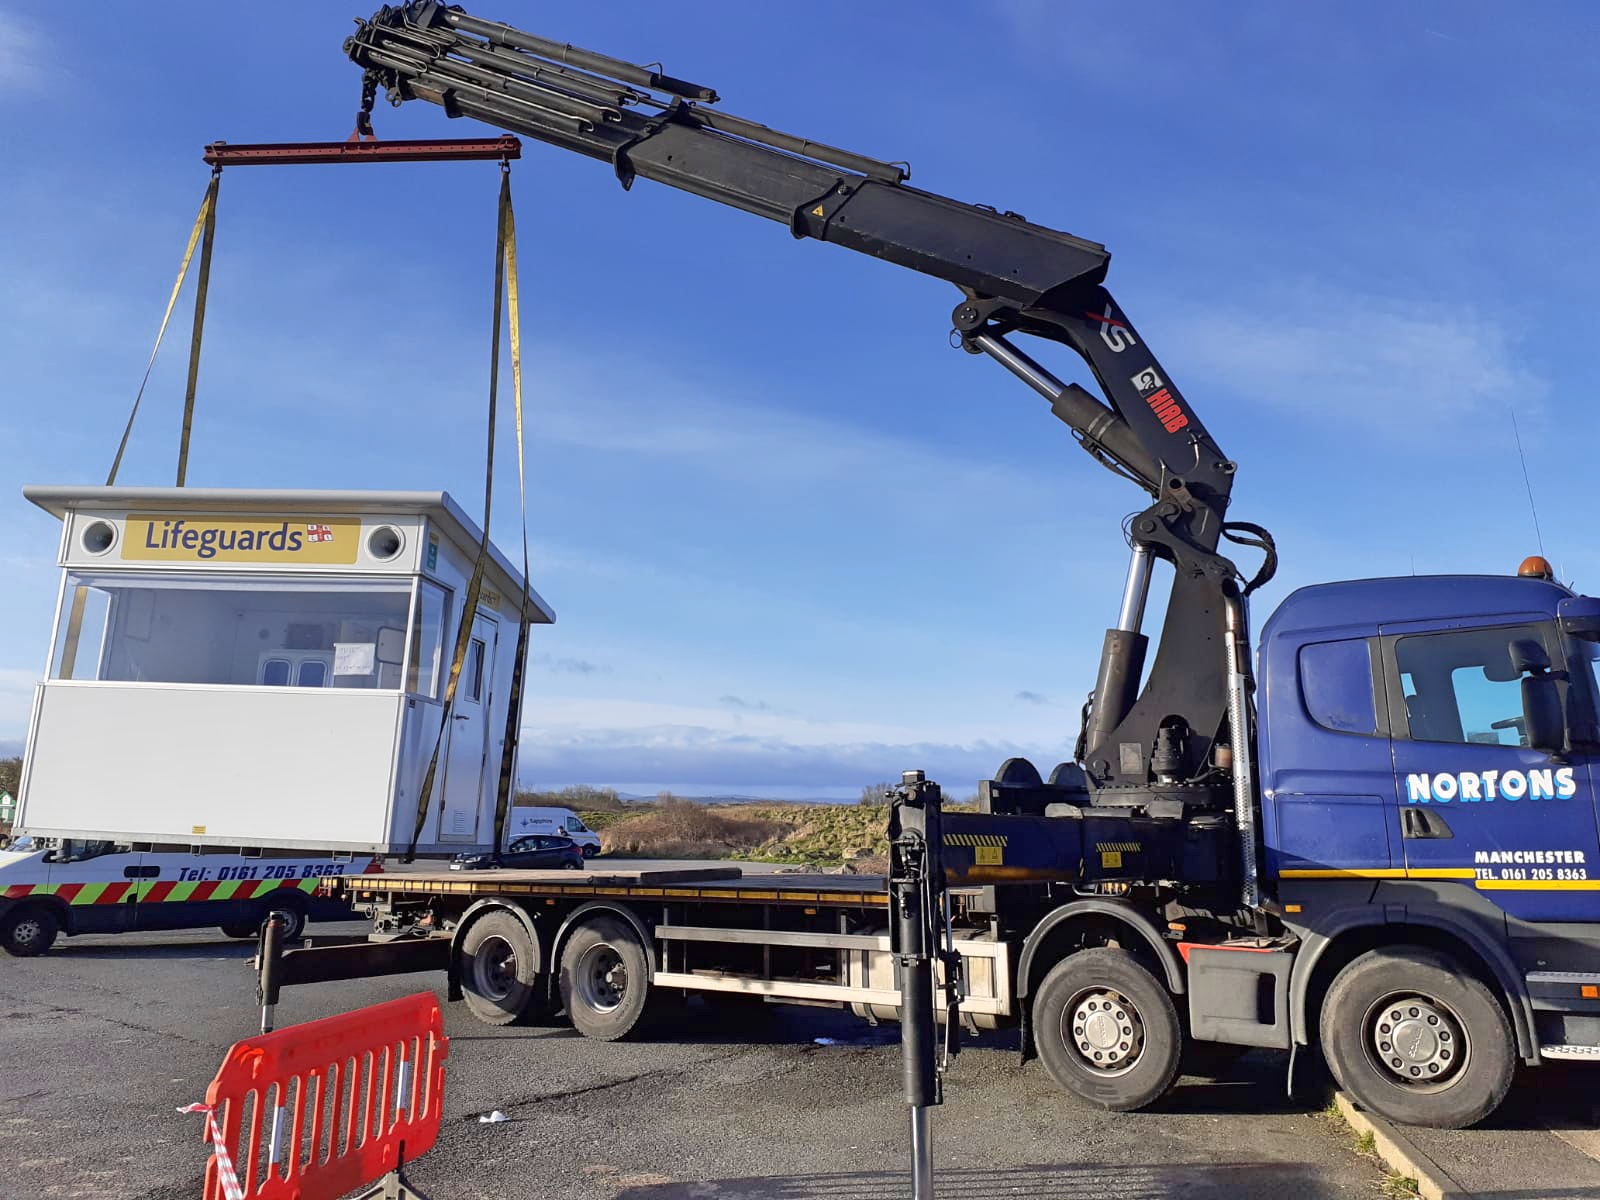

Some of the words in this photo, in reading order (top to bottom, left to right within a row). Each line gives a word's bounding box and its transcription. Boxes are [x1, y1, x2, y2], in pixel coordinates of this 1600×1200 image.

[1086, 303, 1137, 353] XS
[1146, 388, 1189, 433] HIAB
[145, 520, 303, 558] Lifeguards
[1405, 767, 1577, 804] NORTONS
[178, 867, 211, 882] Tel:
[217, 866, 258, 881] 0161
[263, 865, 298, 880] 205
[301, 864, 345, 878] 8363
[1474, 850, 1586, 864] MANCHESTER
[1475, 868, 1499, 880] TEL.
[1501, 867, 1527, 880] 0161
[1531, 867, 1553, 880] 205
[1556, 867, 1587, 880] 8363
